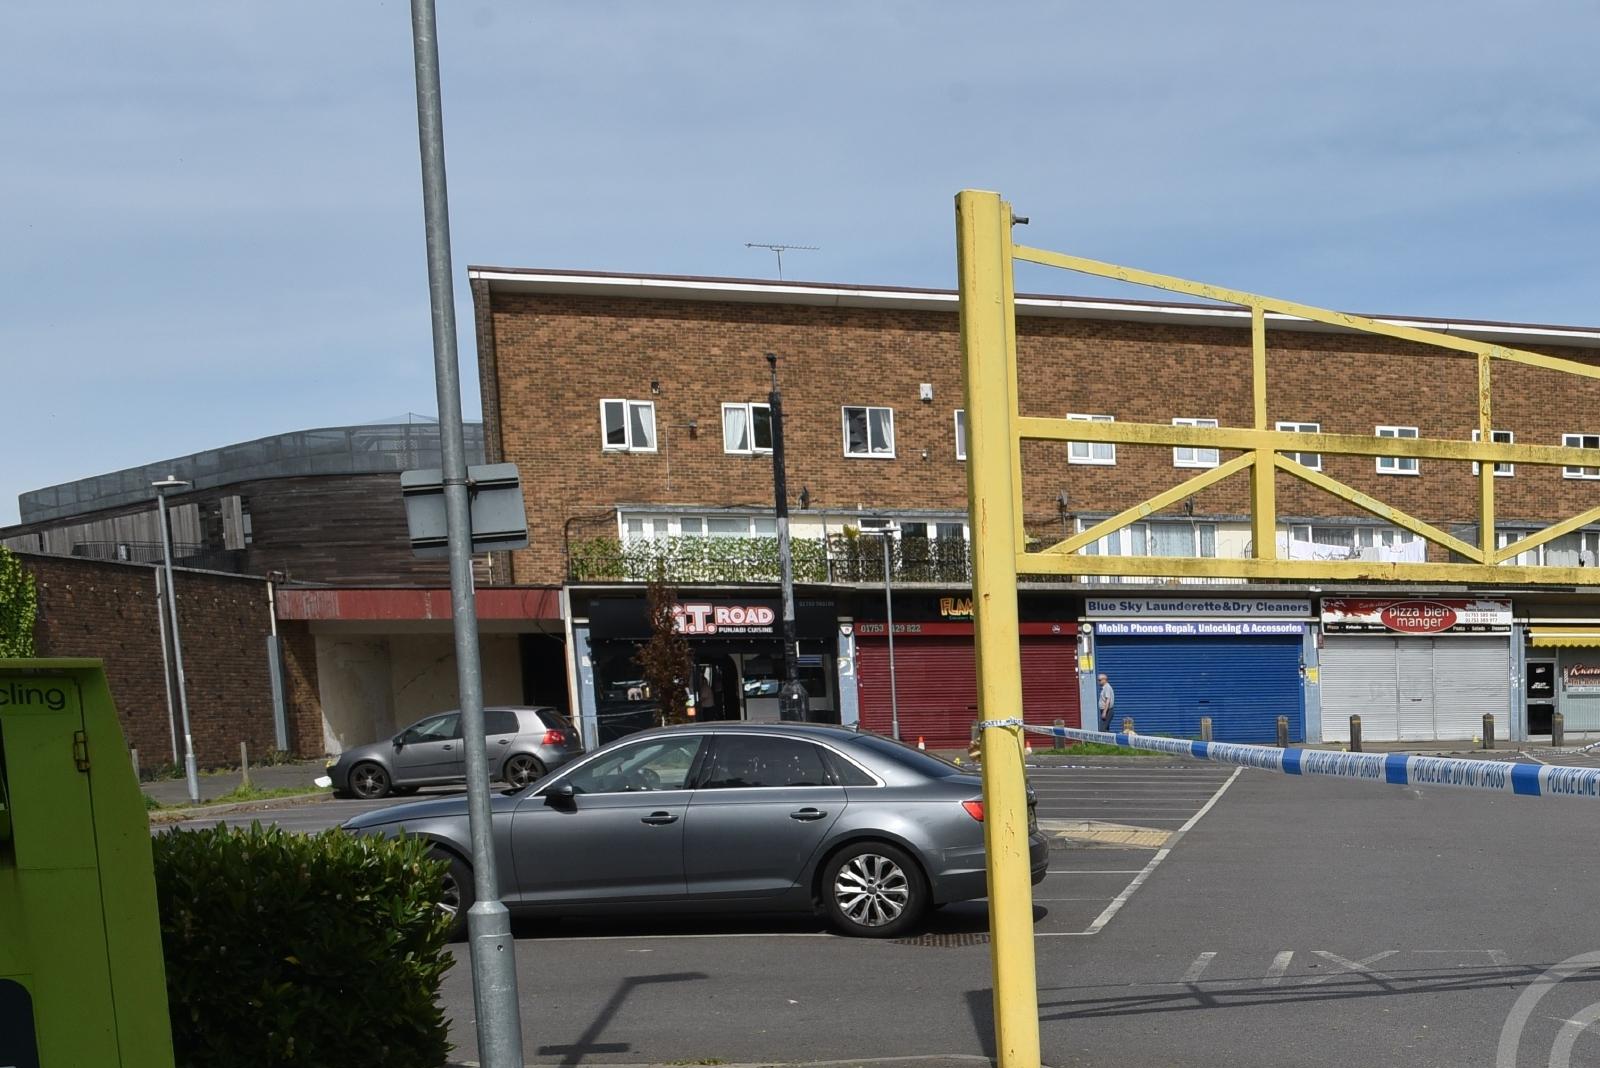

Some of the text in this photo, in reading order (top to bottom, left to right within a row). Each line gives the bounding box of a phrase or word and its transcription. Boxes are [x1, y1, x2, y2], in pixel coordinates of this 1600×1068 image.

[1088, 601, 1117, 612] Blue
[1120, 601, 1143, 613] Sky
[1146, 601, 1253, 613] Launderette&Dry
[1256, 601, 1310, 613] Cleaners
[1389, 605, 1420, 619] pizza
[1424, 605, 1449, 617] bien
[715, 607, 775, 626] ROAD
[1396, 616, 1443, 629] manger
[718, 626, 774, 634] PUNJABI CUISINE
[1099, 623, 1302, 635] Mobile Phones Repair, Unlocking & Accessories
[1546, 768, 1580, 794] POLICE
[1577, 770, 1600, 796] LINE
